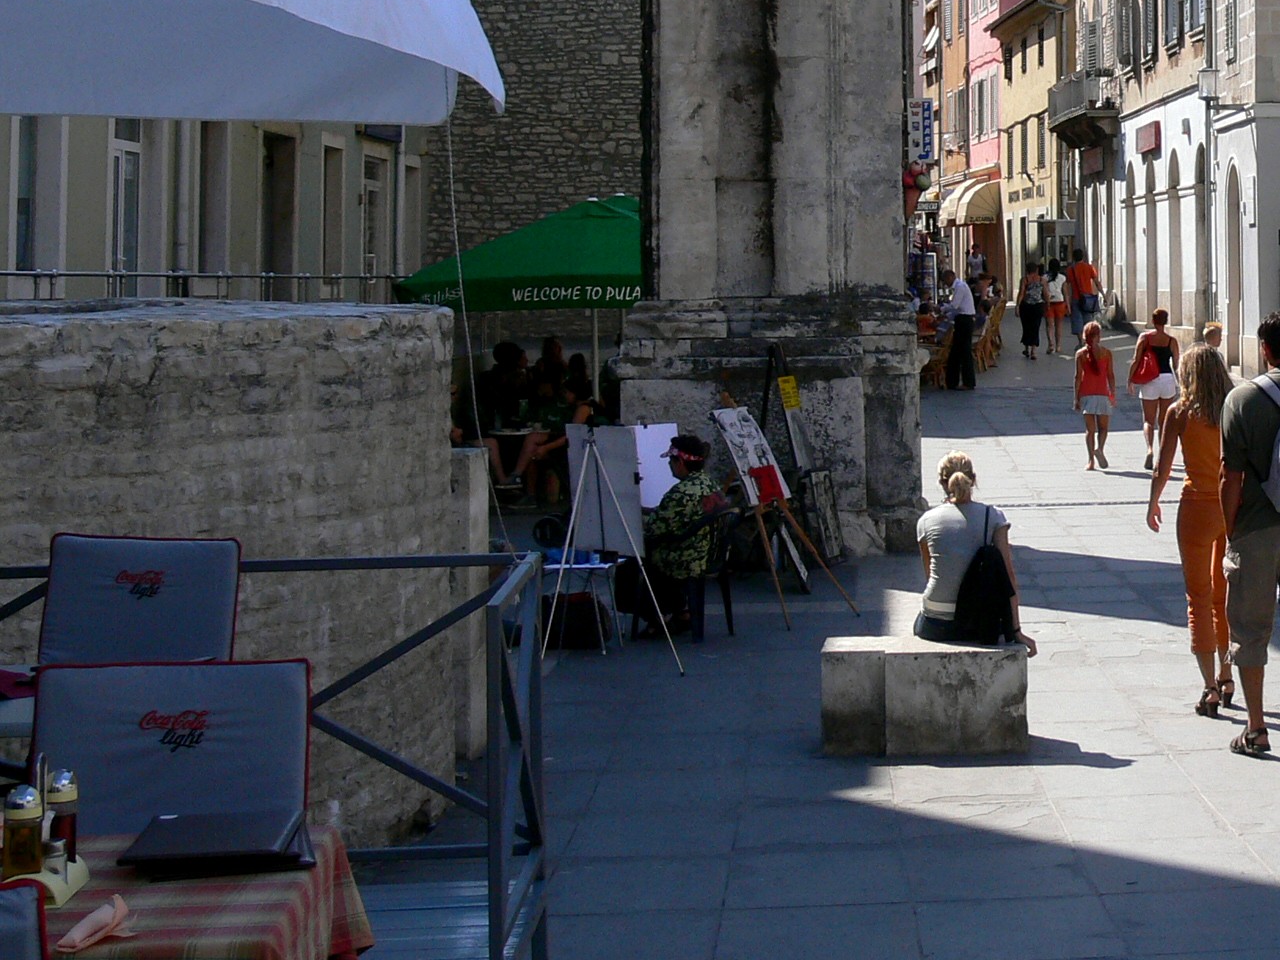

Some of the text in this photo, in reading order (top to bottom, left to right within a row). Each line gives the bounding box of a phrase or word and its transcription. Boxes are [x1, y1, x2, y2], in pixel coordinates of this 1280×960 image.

[923, 102, 931, 152] TERASA
[512, 285, 641, 302] WELCOME TO PULA
[129, 584, 161, 600] light
[158, 728, 204, 753] light
